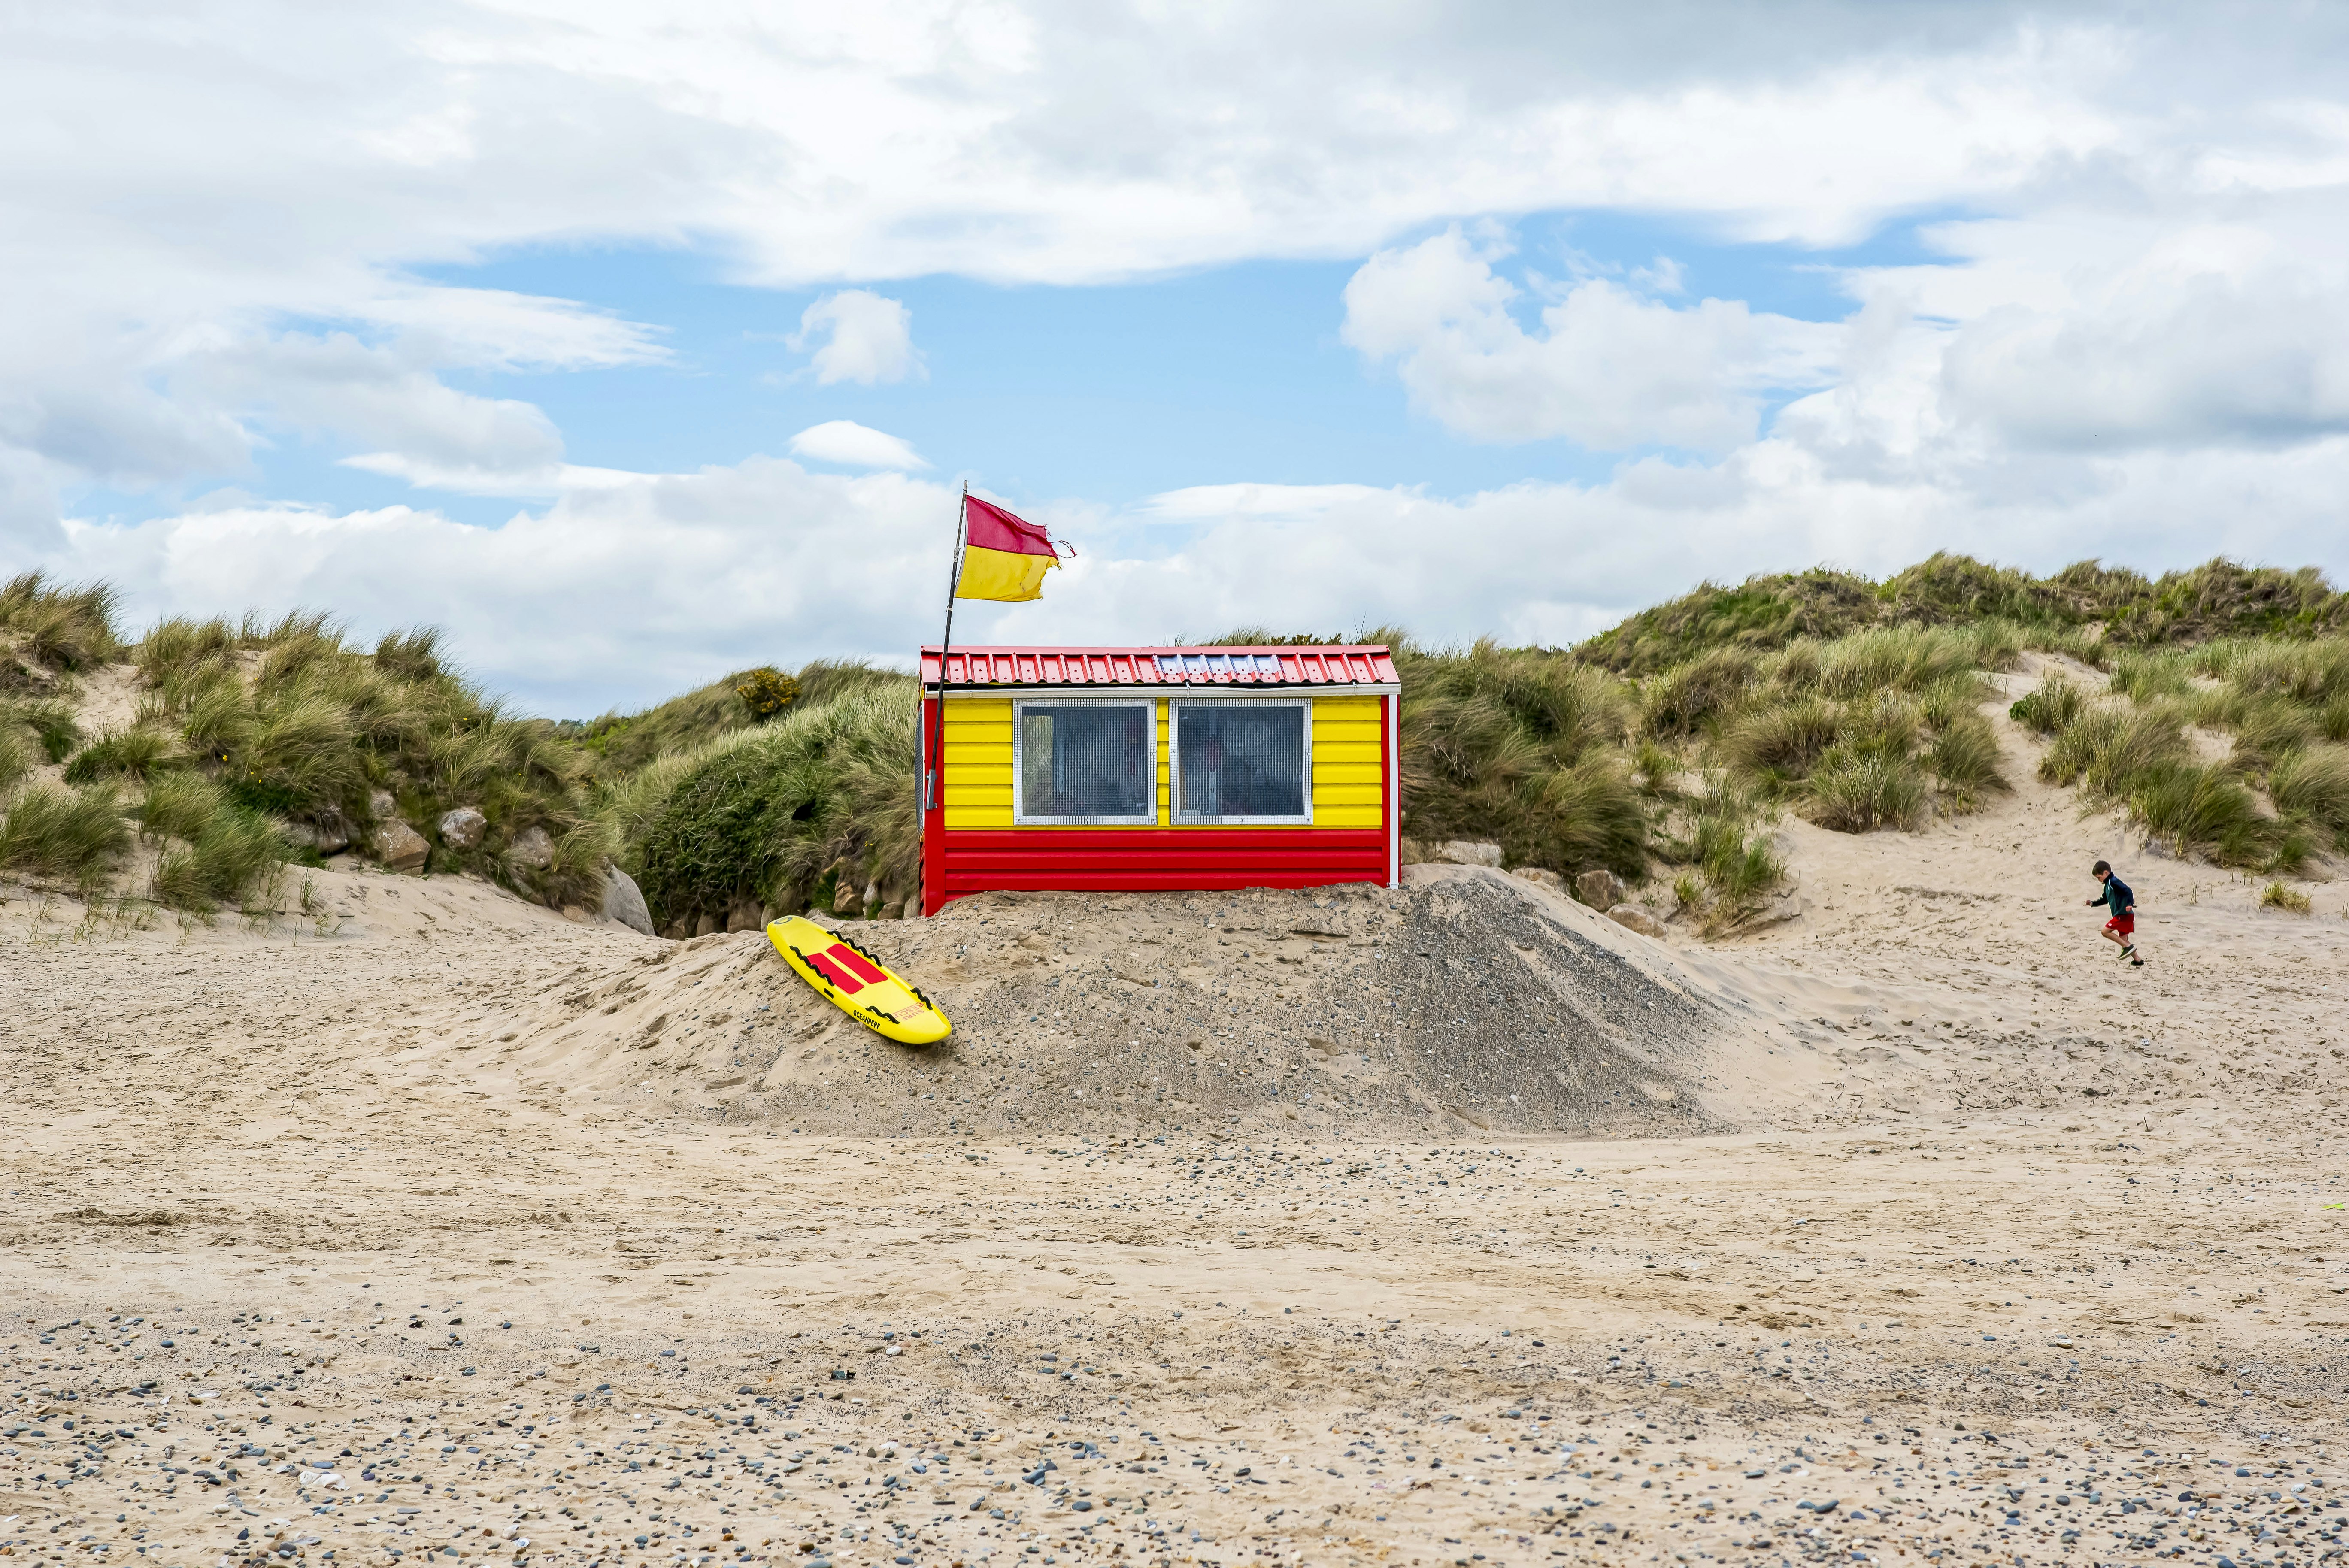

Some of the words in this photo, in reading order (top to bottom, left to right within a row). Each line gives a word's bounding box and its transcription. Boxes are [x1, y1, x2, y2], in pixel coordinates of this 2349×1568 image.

[894, 1002, 924, 1018] RESCU
[903, 1009, 924, 1020] SURF
[853, 1010, 880, 1030] OCEANPERF
